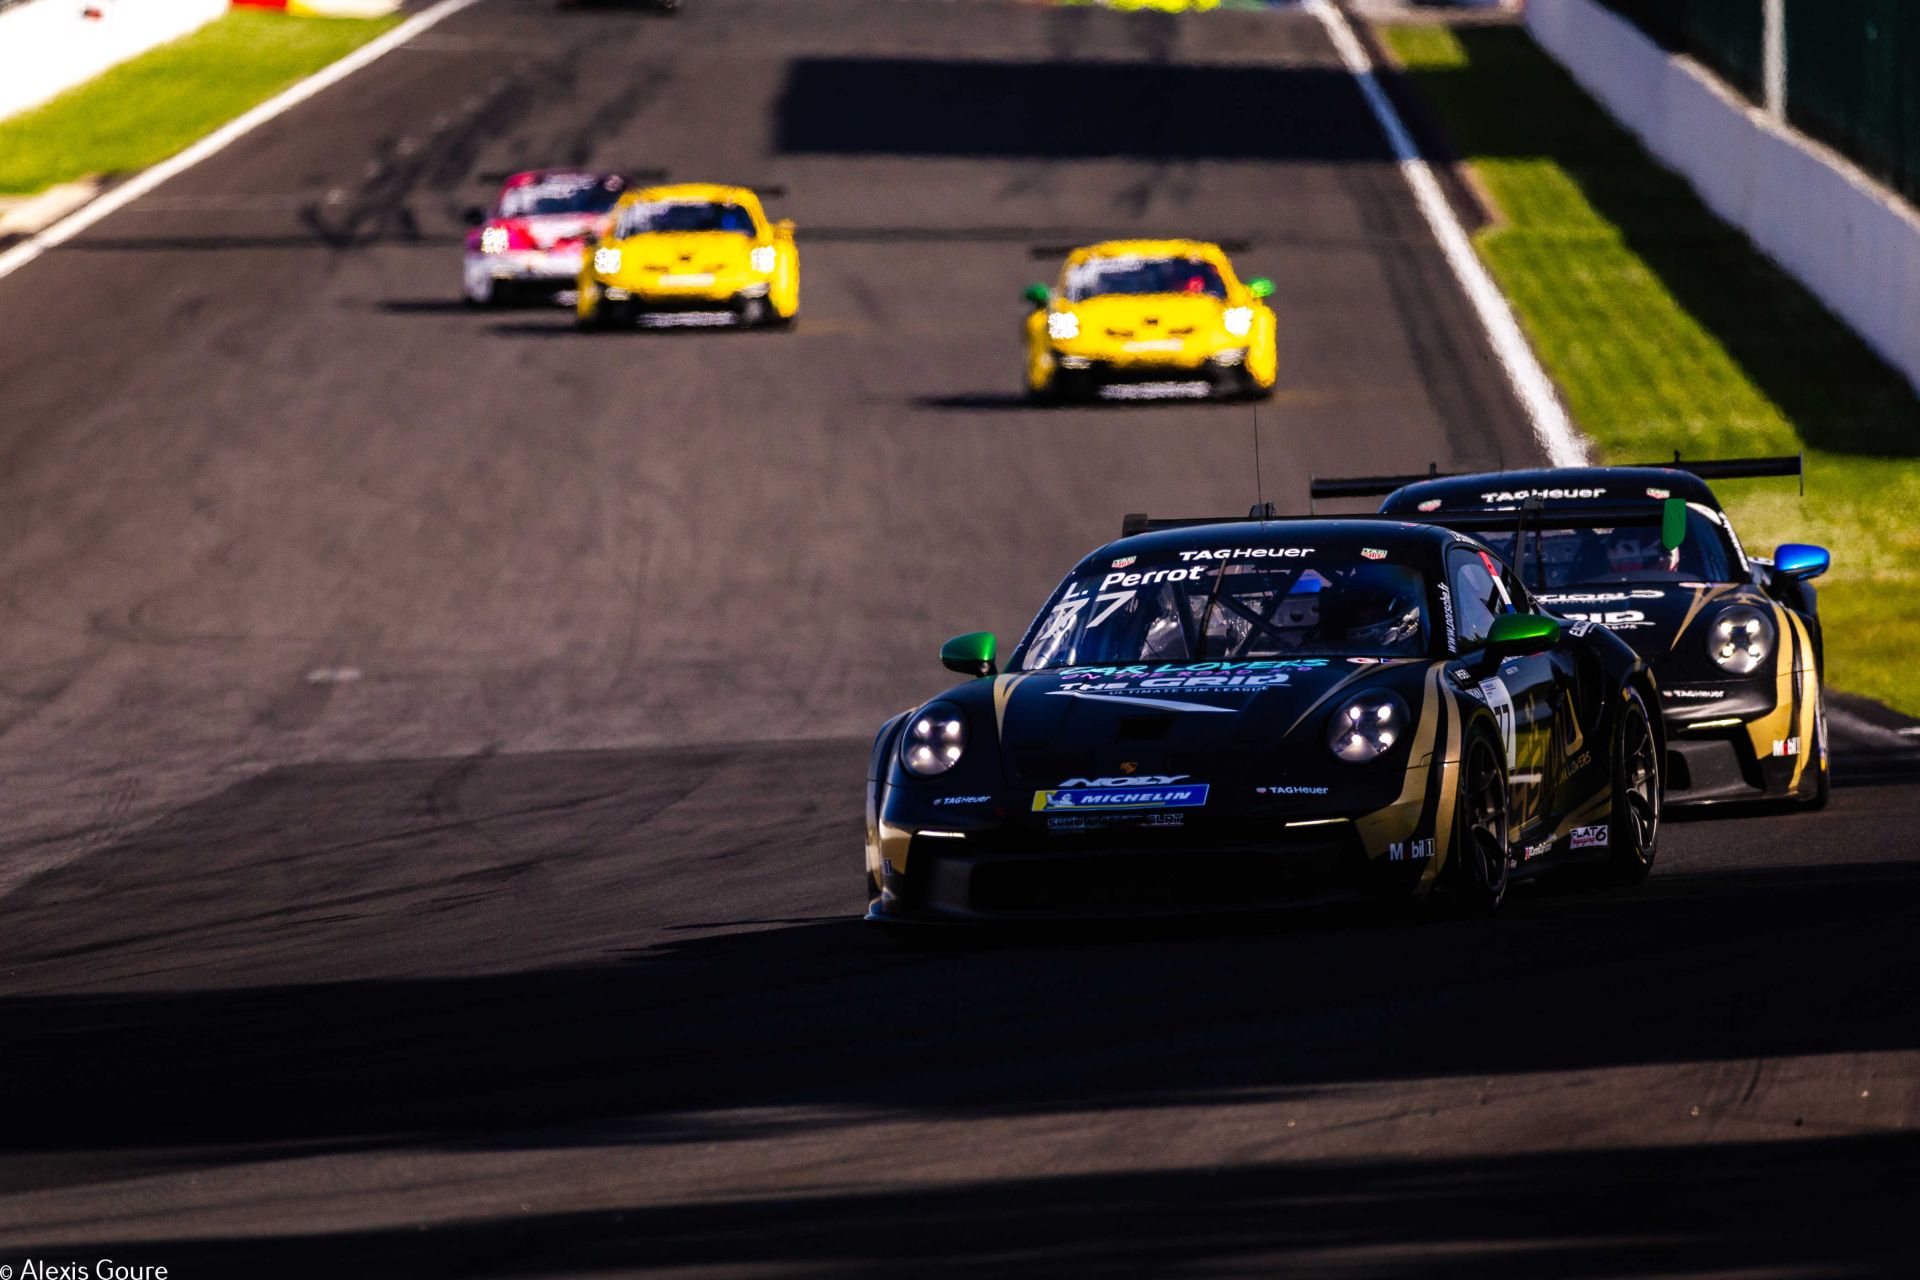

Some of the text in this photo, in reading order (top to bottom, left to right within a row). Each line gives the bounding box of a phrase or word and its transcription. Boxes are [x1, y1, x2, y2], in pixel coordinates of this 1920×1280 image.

[1062, 565, 1204, 600] L. Perrot
[1039, 590, 1137, 640] 77
[1437, 582, 1456, 653] www.porsche.fr
[1059, 659, 1330, 676] CAR LOVERS
[1060, 682, 1129, 691] THE
[1213, 685, 1269, 693] LEAGUE
[1080, 791, 1191, 804] MICHELIN
[1571, 826, 1598, 838] FLAT
[1595, 826, 1607, 842] 6
